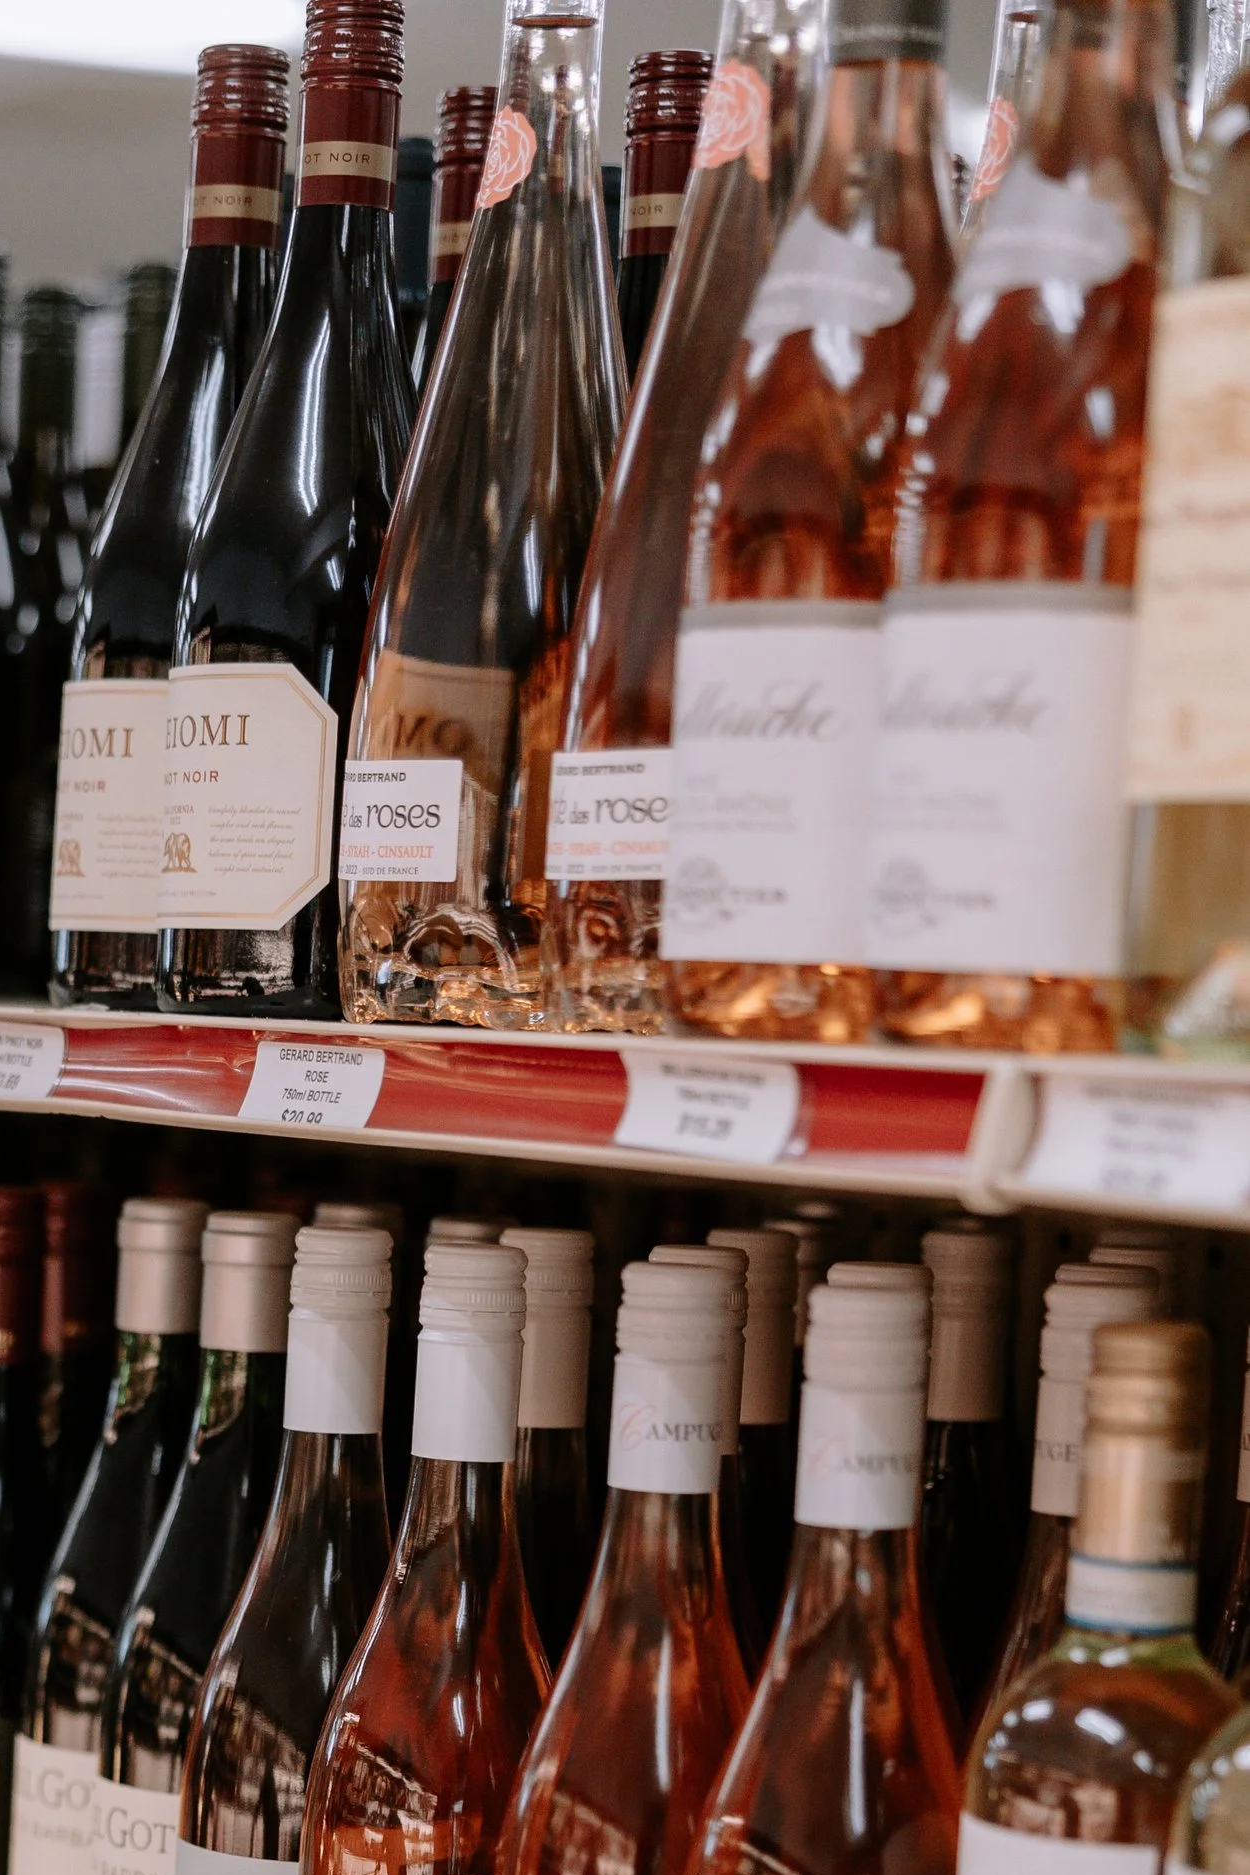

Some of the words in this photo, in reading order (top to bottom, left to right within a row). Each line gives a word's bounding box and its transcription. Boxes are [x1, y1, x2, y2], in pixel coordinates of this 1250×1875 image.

[329, 153, 371, 165] NOIR
[183, 770, 220, 784] NOIR
[357, 772, 407, 783] BERTRAND
[74, 780, 107, 794] NOIR
[366, 804, 441, 829] roses
[377, 845, 435, 859] CINSAULT
[362, 866, 375, 875] SUD
[376, 866, 387, 875] DE
[387, 866, 419, 876] FRANCE
[279, 1047, 315, 1063] GERARD
[315, 1051, 364, 1066] BERTRAND
[304, 1069, 330, 1084] ROSE
[281, 1087, 307, 1102] 750ml
[306, 1089, 343, 1104] BOTTLE
